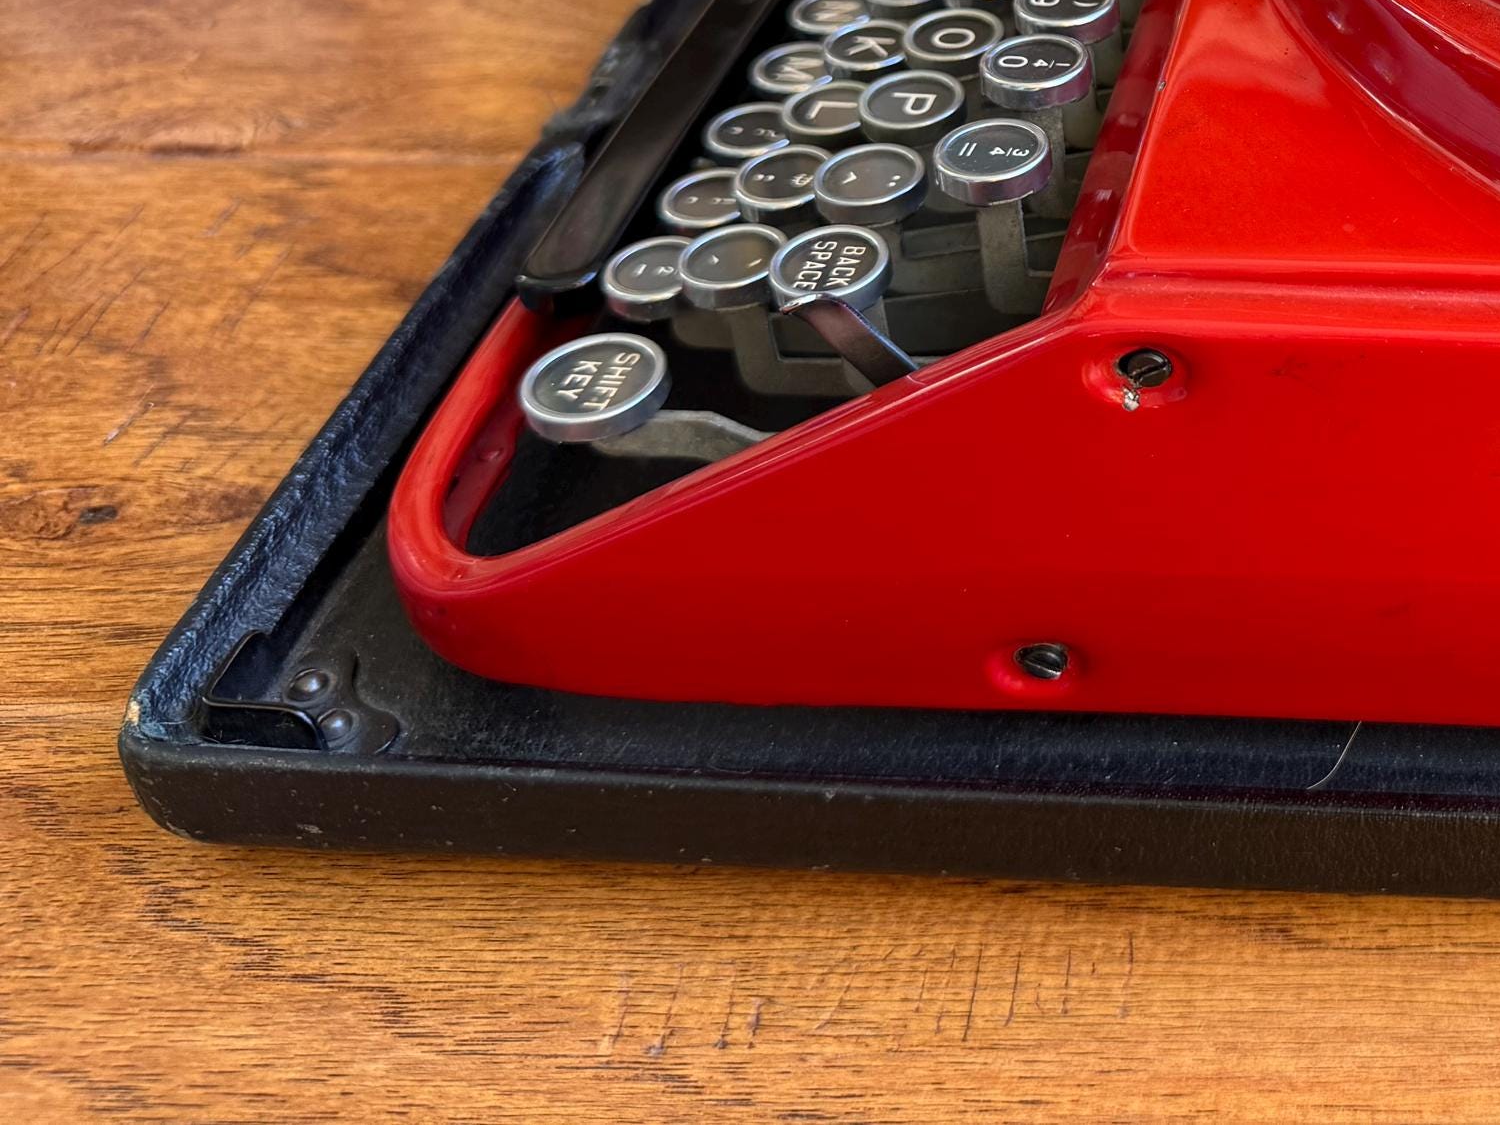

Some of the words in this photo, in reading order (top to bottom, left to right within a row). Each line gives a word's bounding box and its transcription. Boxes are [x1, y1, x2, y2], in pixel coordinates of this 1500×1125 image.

[846, 35, 896, 58] K
[931, 27, 976, 49] O
[806, 100, 858, 121] L
[893, 91, 938, 116] P
[793, 240, 838, 291] SPACE
[826, 246, 867, 288] BACK
[556, 360, 603, 402] KEY
[583, 352, 642, 411] SHIFT
